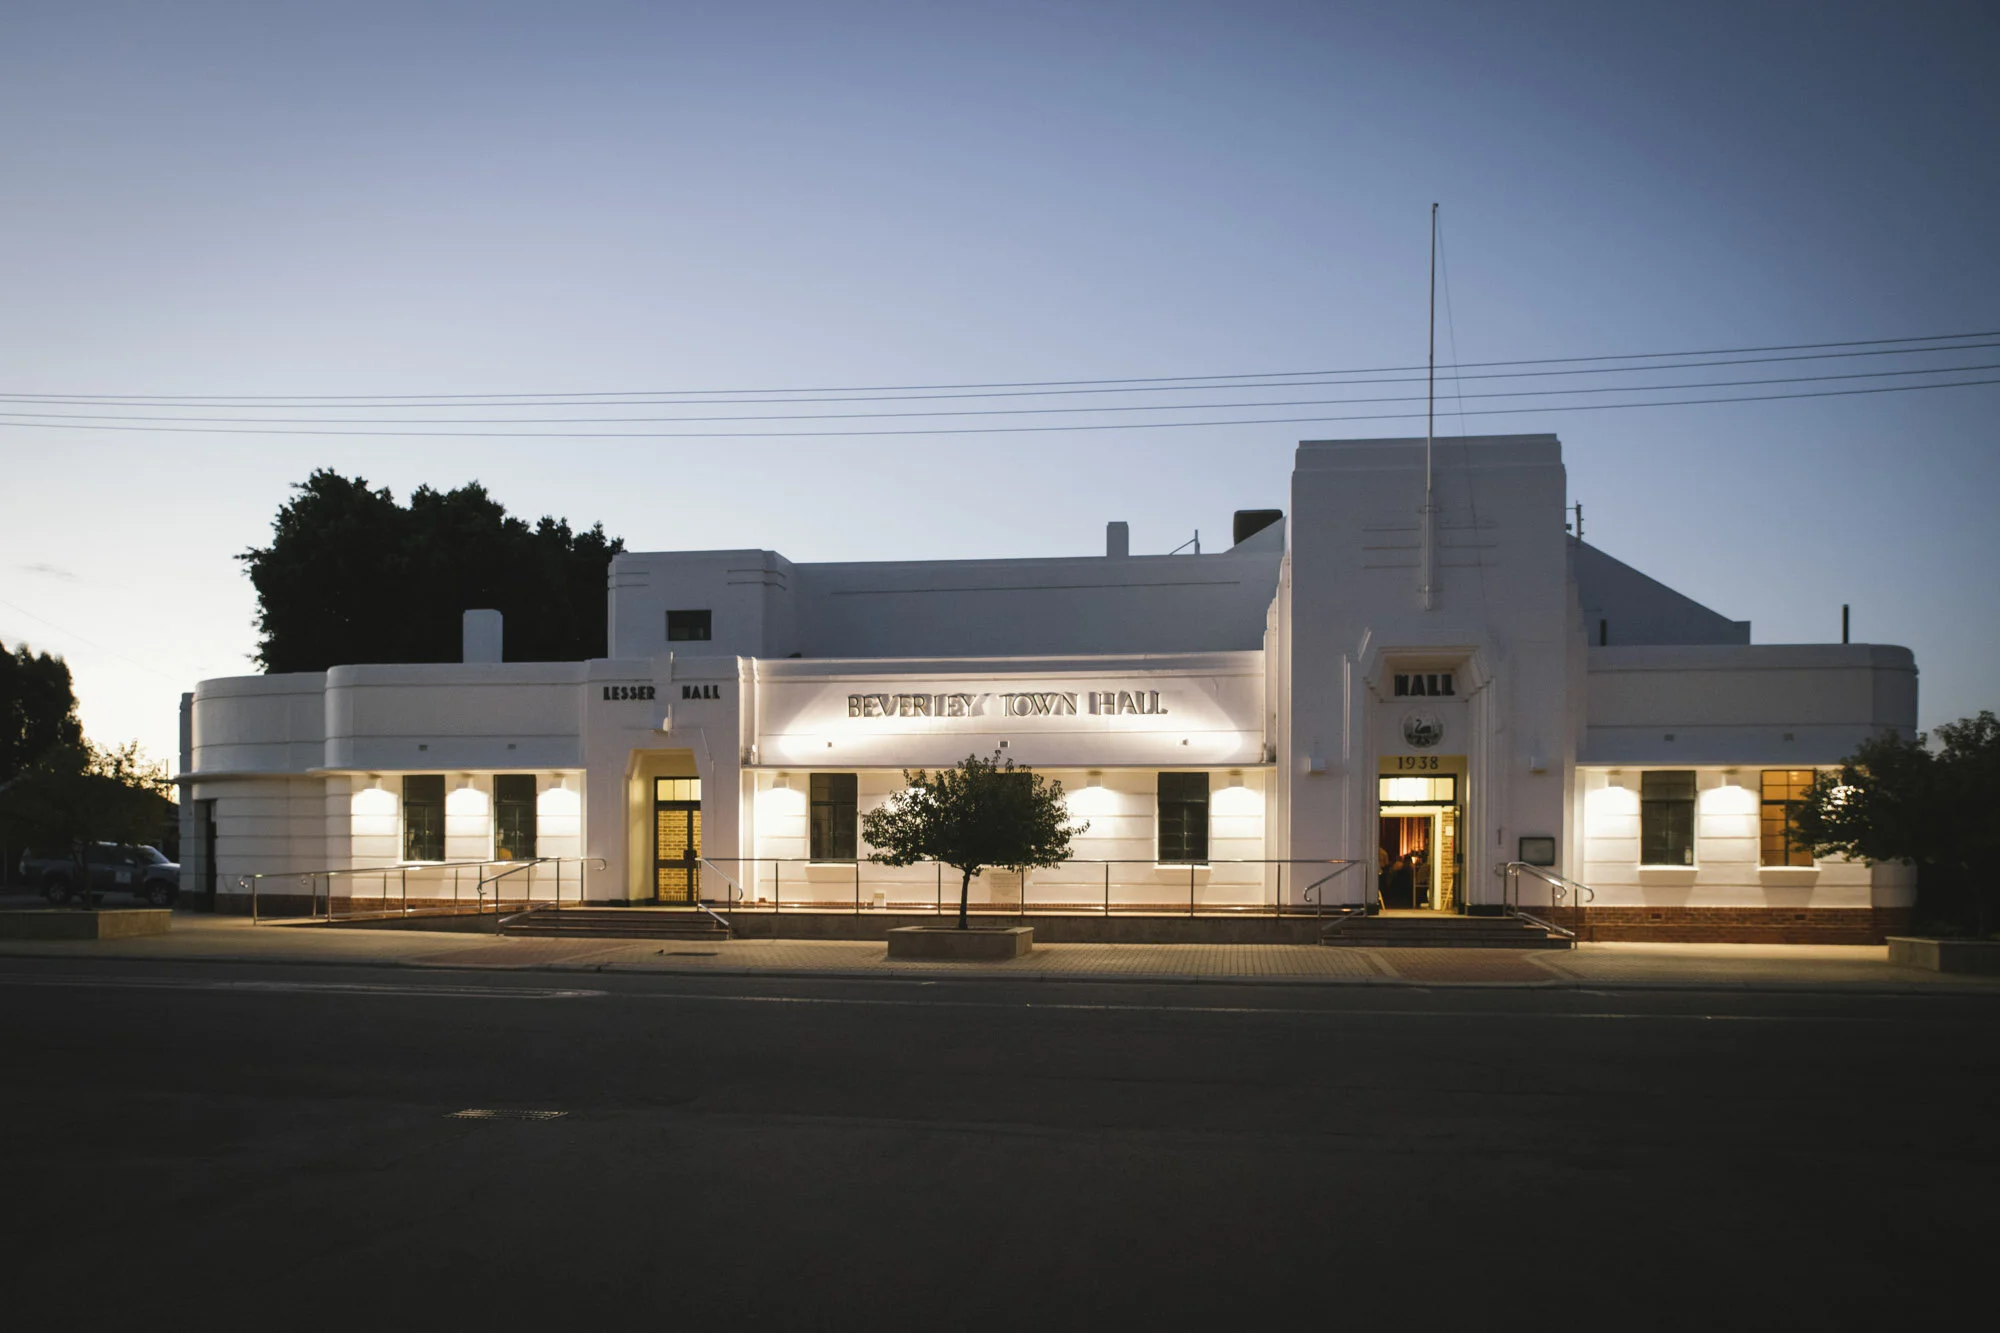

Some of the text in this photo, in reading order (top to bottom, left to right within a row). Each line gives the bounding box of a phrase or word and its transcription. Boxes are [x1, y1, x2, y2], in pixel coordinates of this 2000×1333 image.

[603, 685, 720, 700] LESSER HALL
[1394, 674, 1455, 696] HALL
[848, 691, 1168, 718] BEVERLEY TOWN HALL
[1398, 756, 1439, 770] 1938
